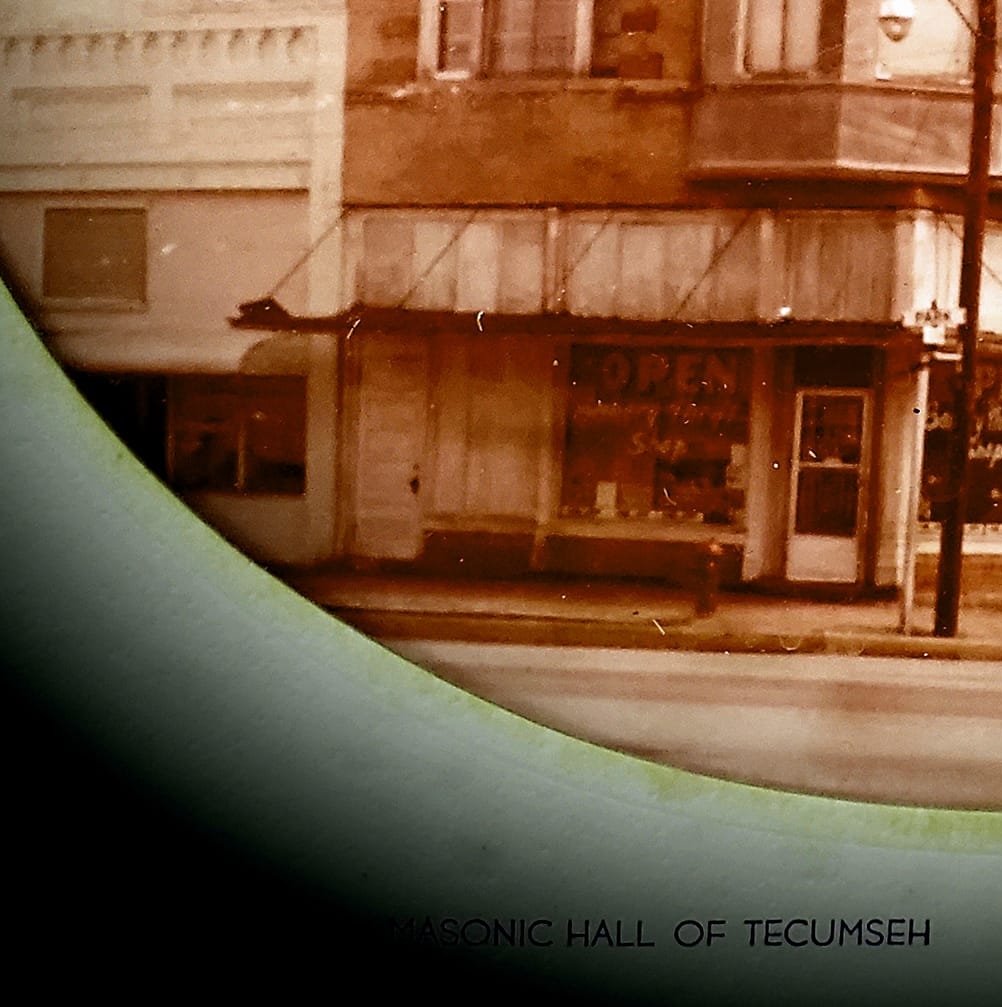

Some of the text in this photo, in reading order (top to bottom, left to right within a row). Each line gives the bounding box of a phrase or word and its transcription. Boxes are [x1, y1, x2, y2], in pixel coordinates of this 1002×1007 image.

[601, 351, 737, 394] OPEN
[566, 919, 655, 948] HALL
[673, 919, 727, 947] OF
[743, 918, 931, 947] TECUMSEH
